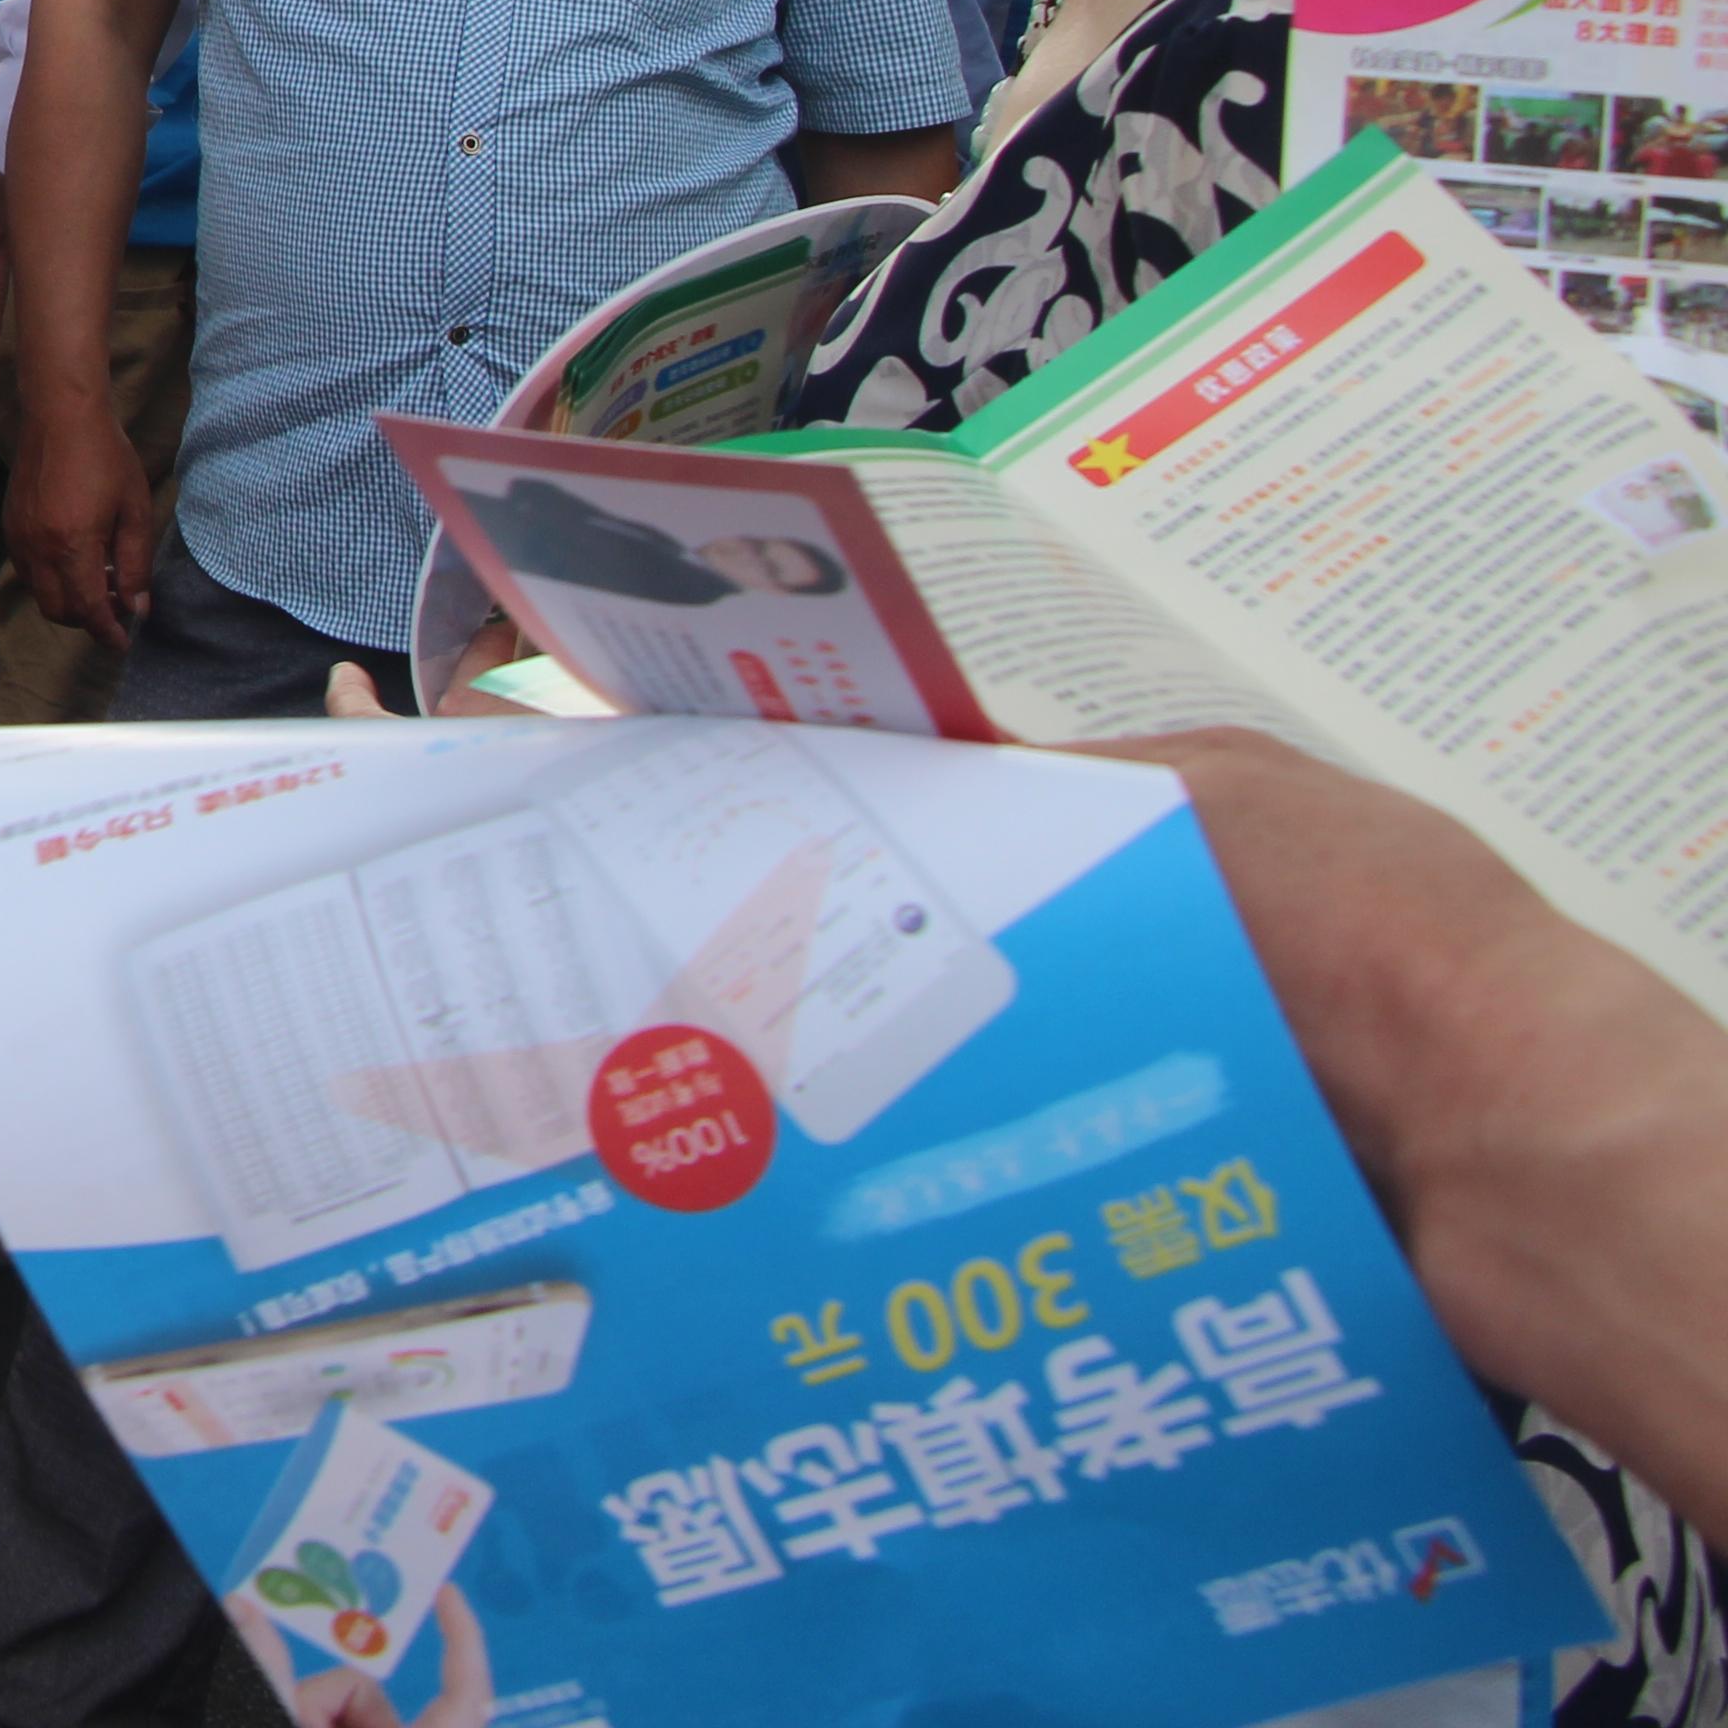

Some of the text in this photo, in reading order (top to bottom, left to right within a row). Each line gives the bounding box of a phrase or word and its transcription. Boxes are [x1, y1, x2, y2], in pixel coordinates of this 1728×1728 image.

[630, 1110, 750, 1180] 100%
[1100, 1157, 1278, 1279] 仅需
[769, 1299, 869, 1386] 元
[885, 1231, 1091, 1374] 300
[601, 1267, 1383, 1609] 高考填志愿
